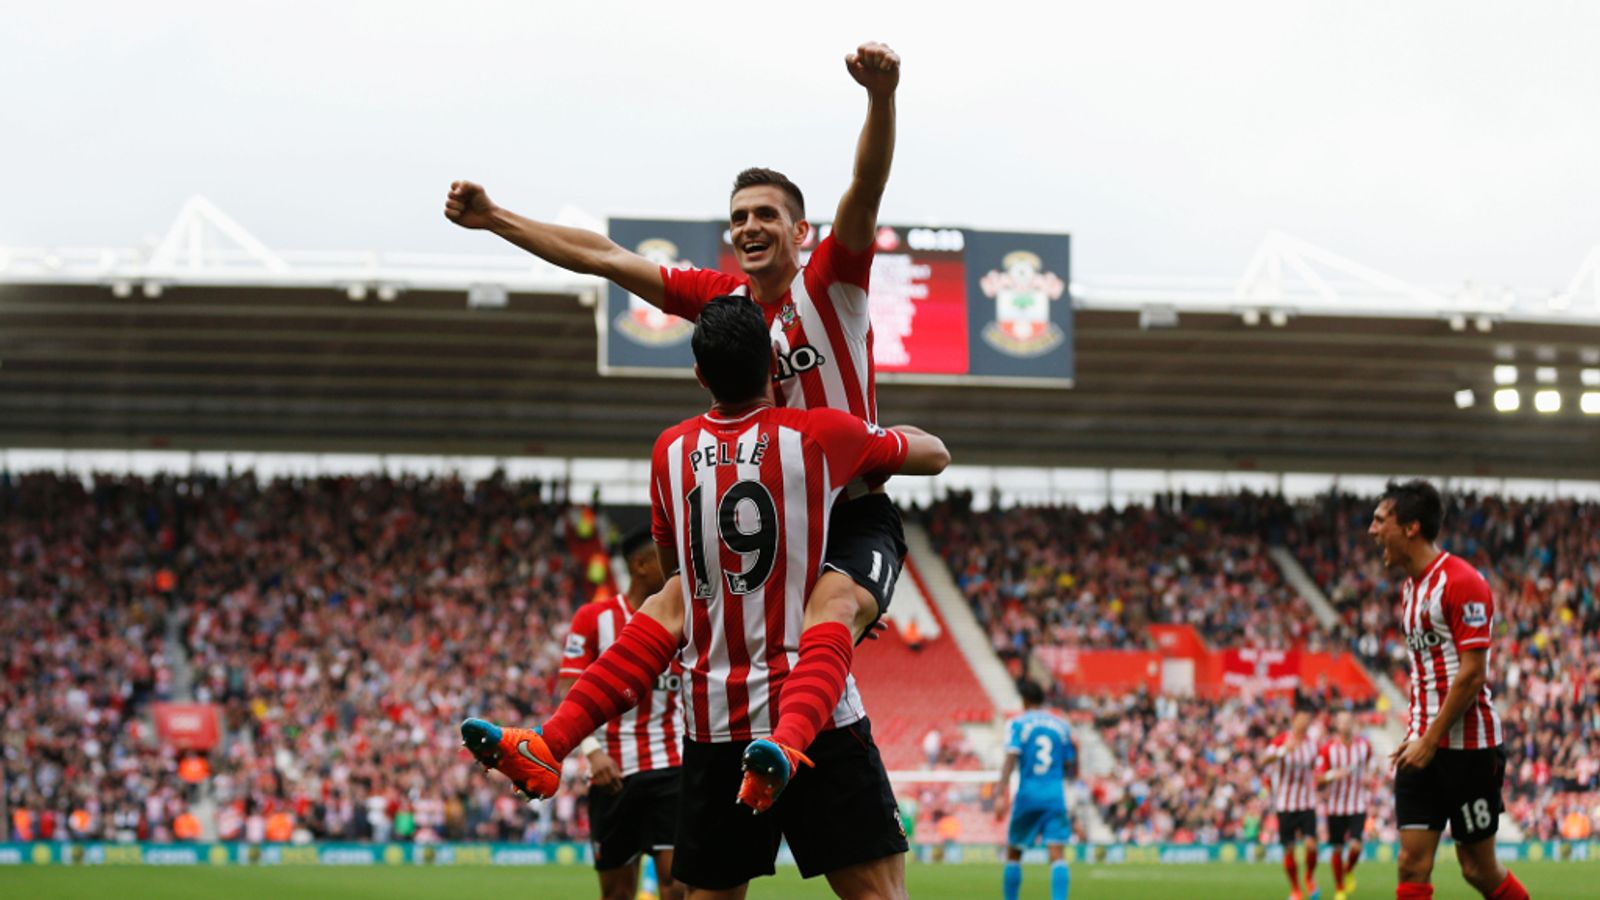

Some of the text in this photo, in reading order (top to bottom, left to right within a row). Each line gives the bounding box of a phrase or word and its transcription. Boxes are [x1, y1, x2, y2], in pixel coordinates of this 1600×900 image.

[686, 479, 779, 599] 19
[1032, 735, 1054, 776] 3
[1460, 798, 1492, 833] 18
